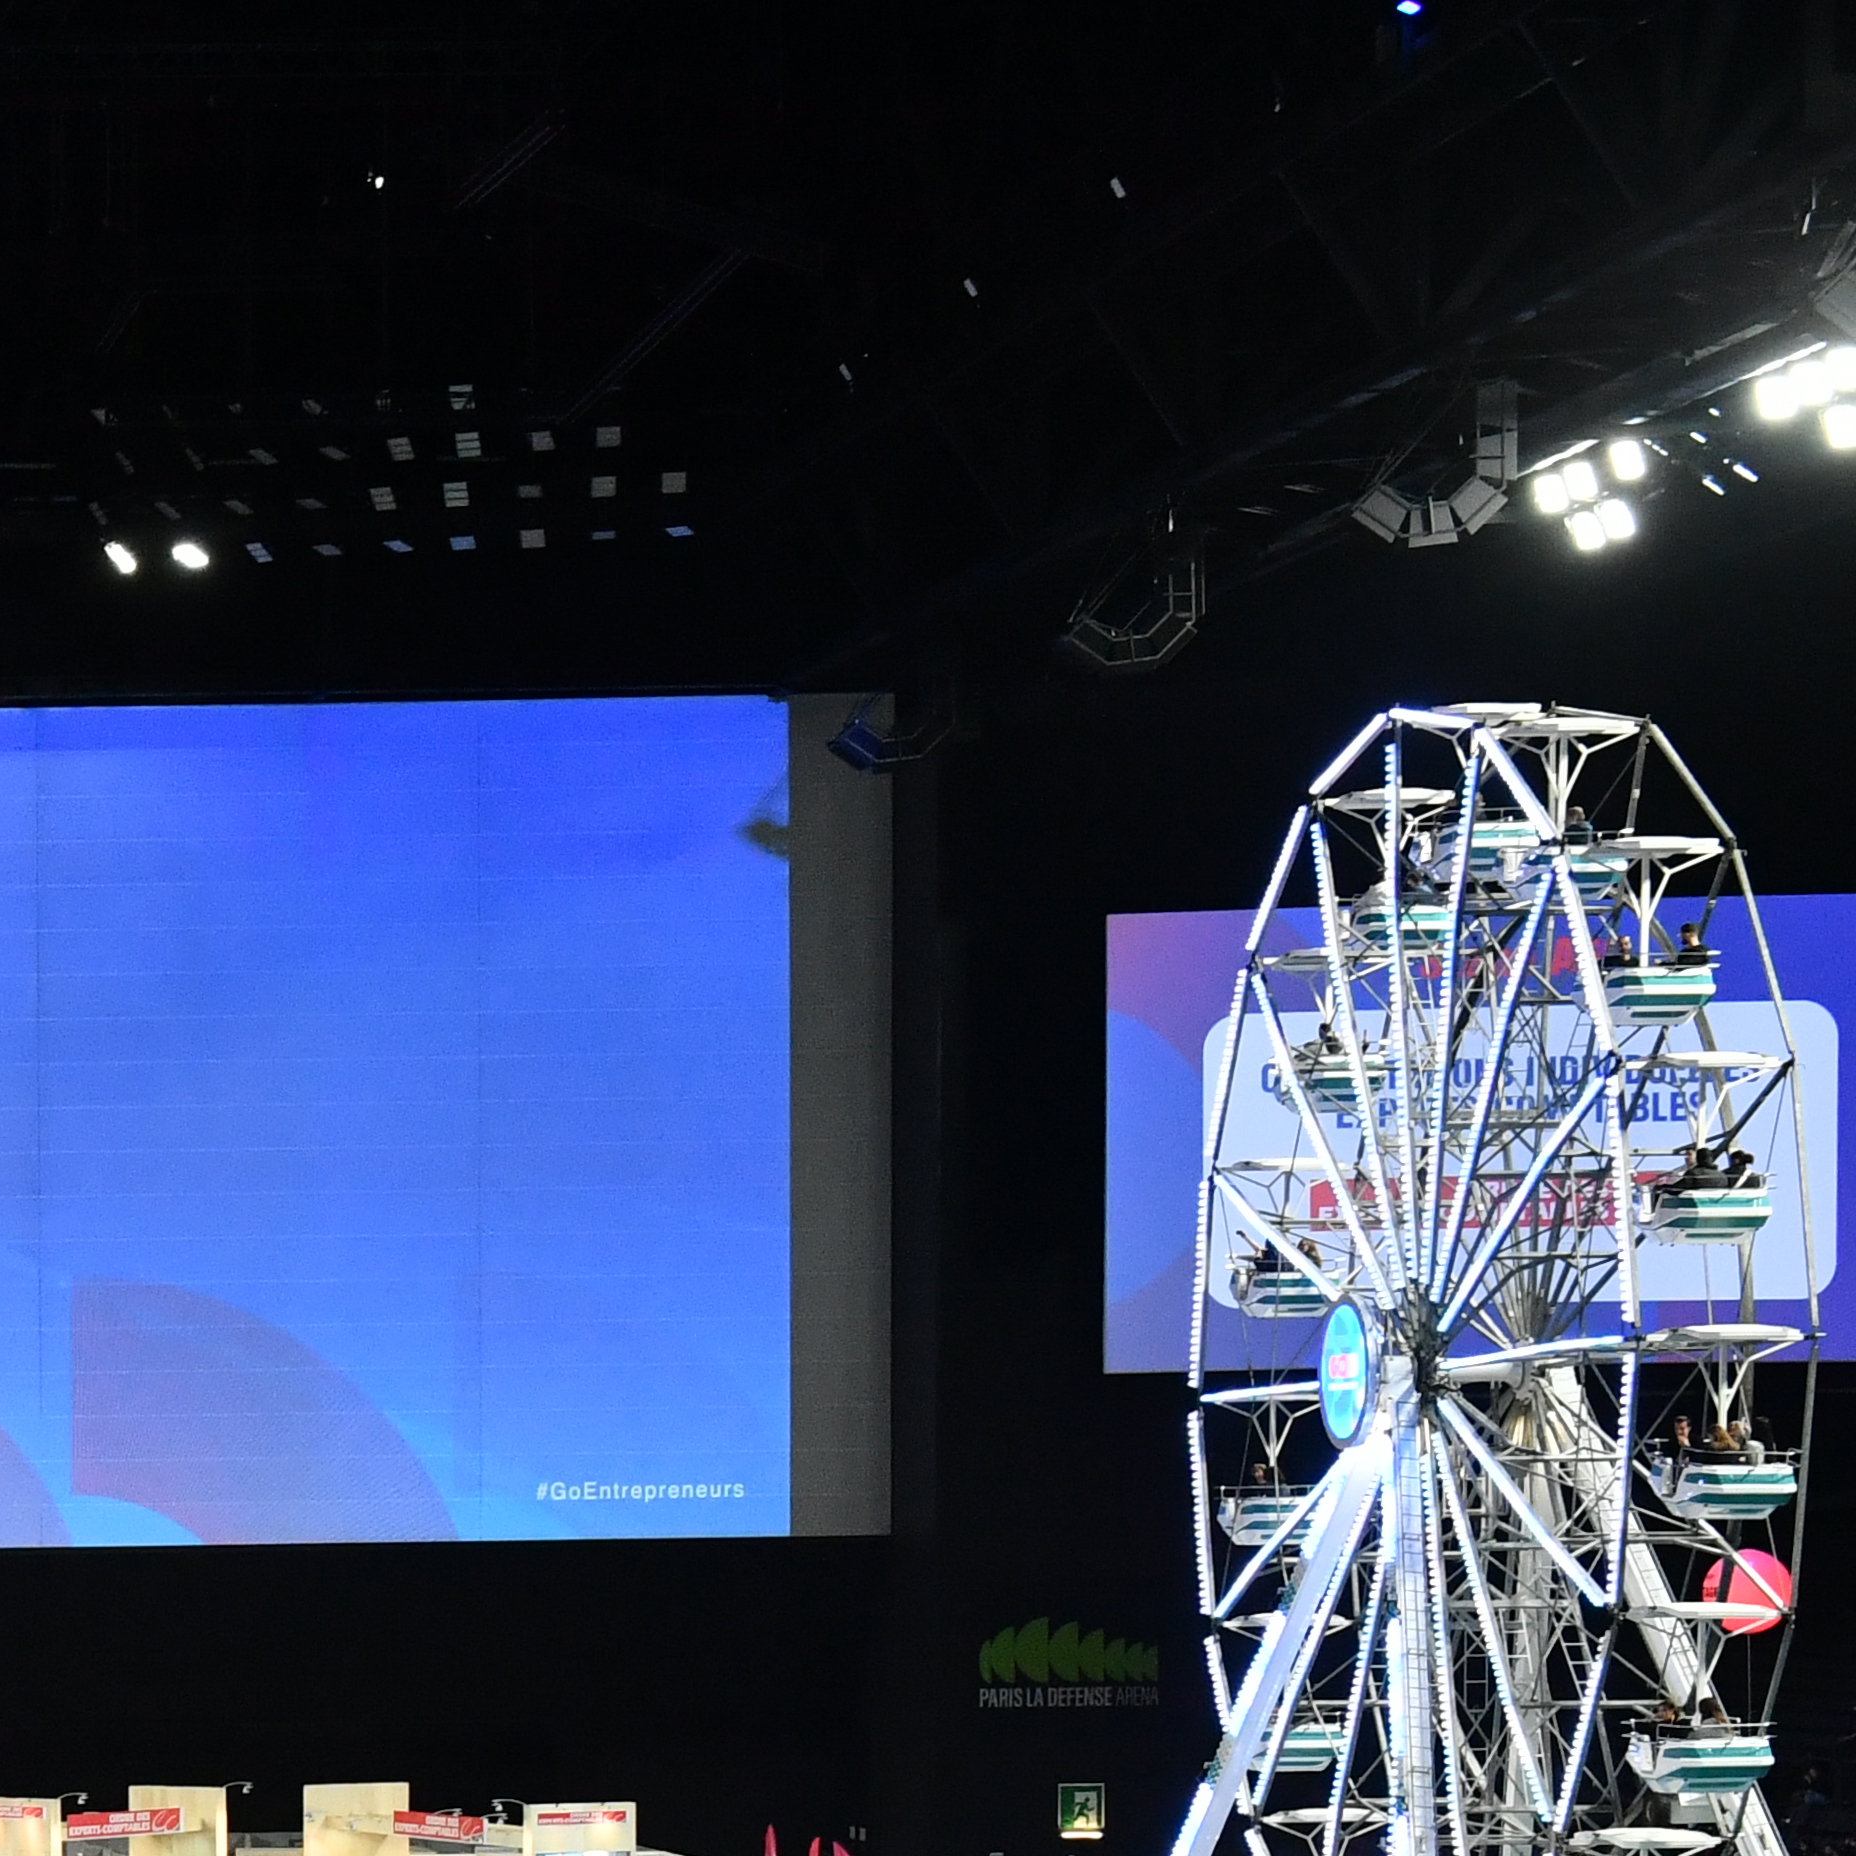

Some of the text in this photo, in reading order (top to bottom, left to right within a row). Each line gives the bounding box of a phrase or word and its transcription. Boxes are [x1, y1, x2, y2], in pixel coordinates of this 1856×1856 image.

[537, 1480, 745, 1502] #GoEntrepreneurs
[979, 1685, 1159, 1708] PARIS LA DEFENSE ARENA
